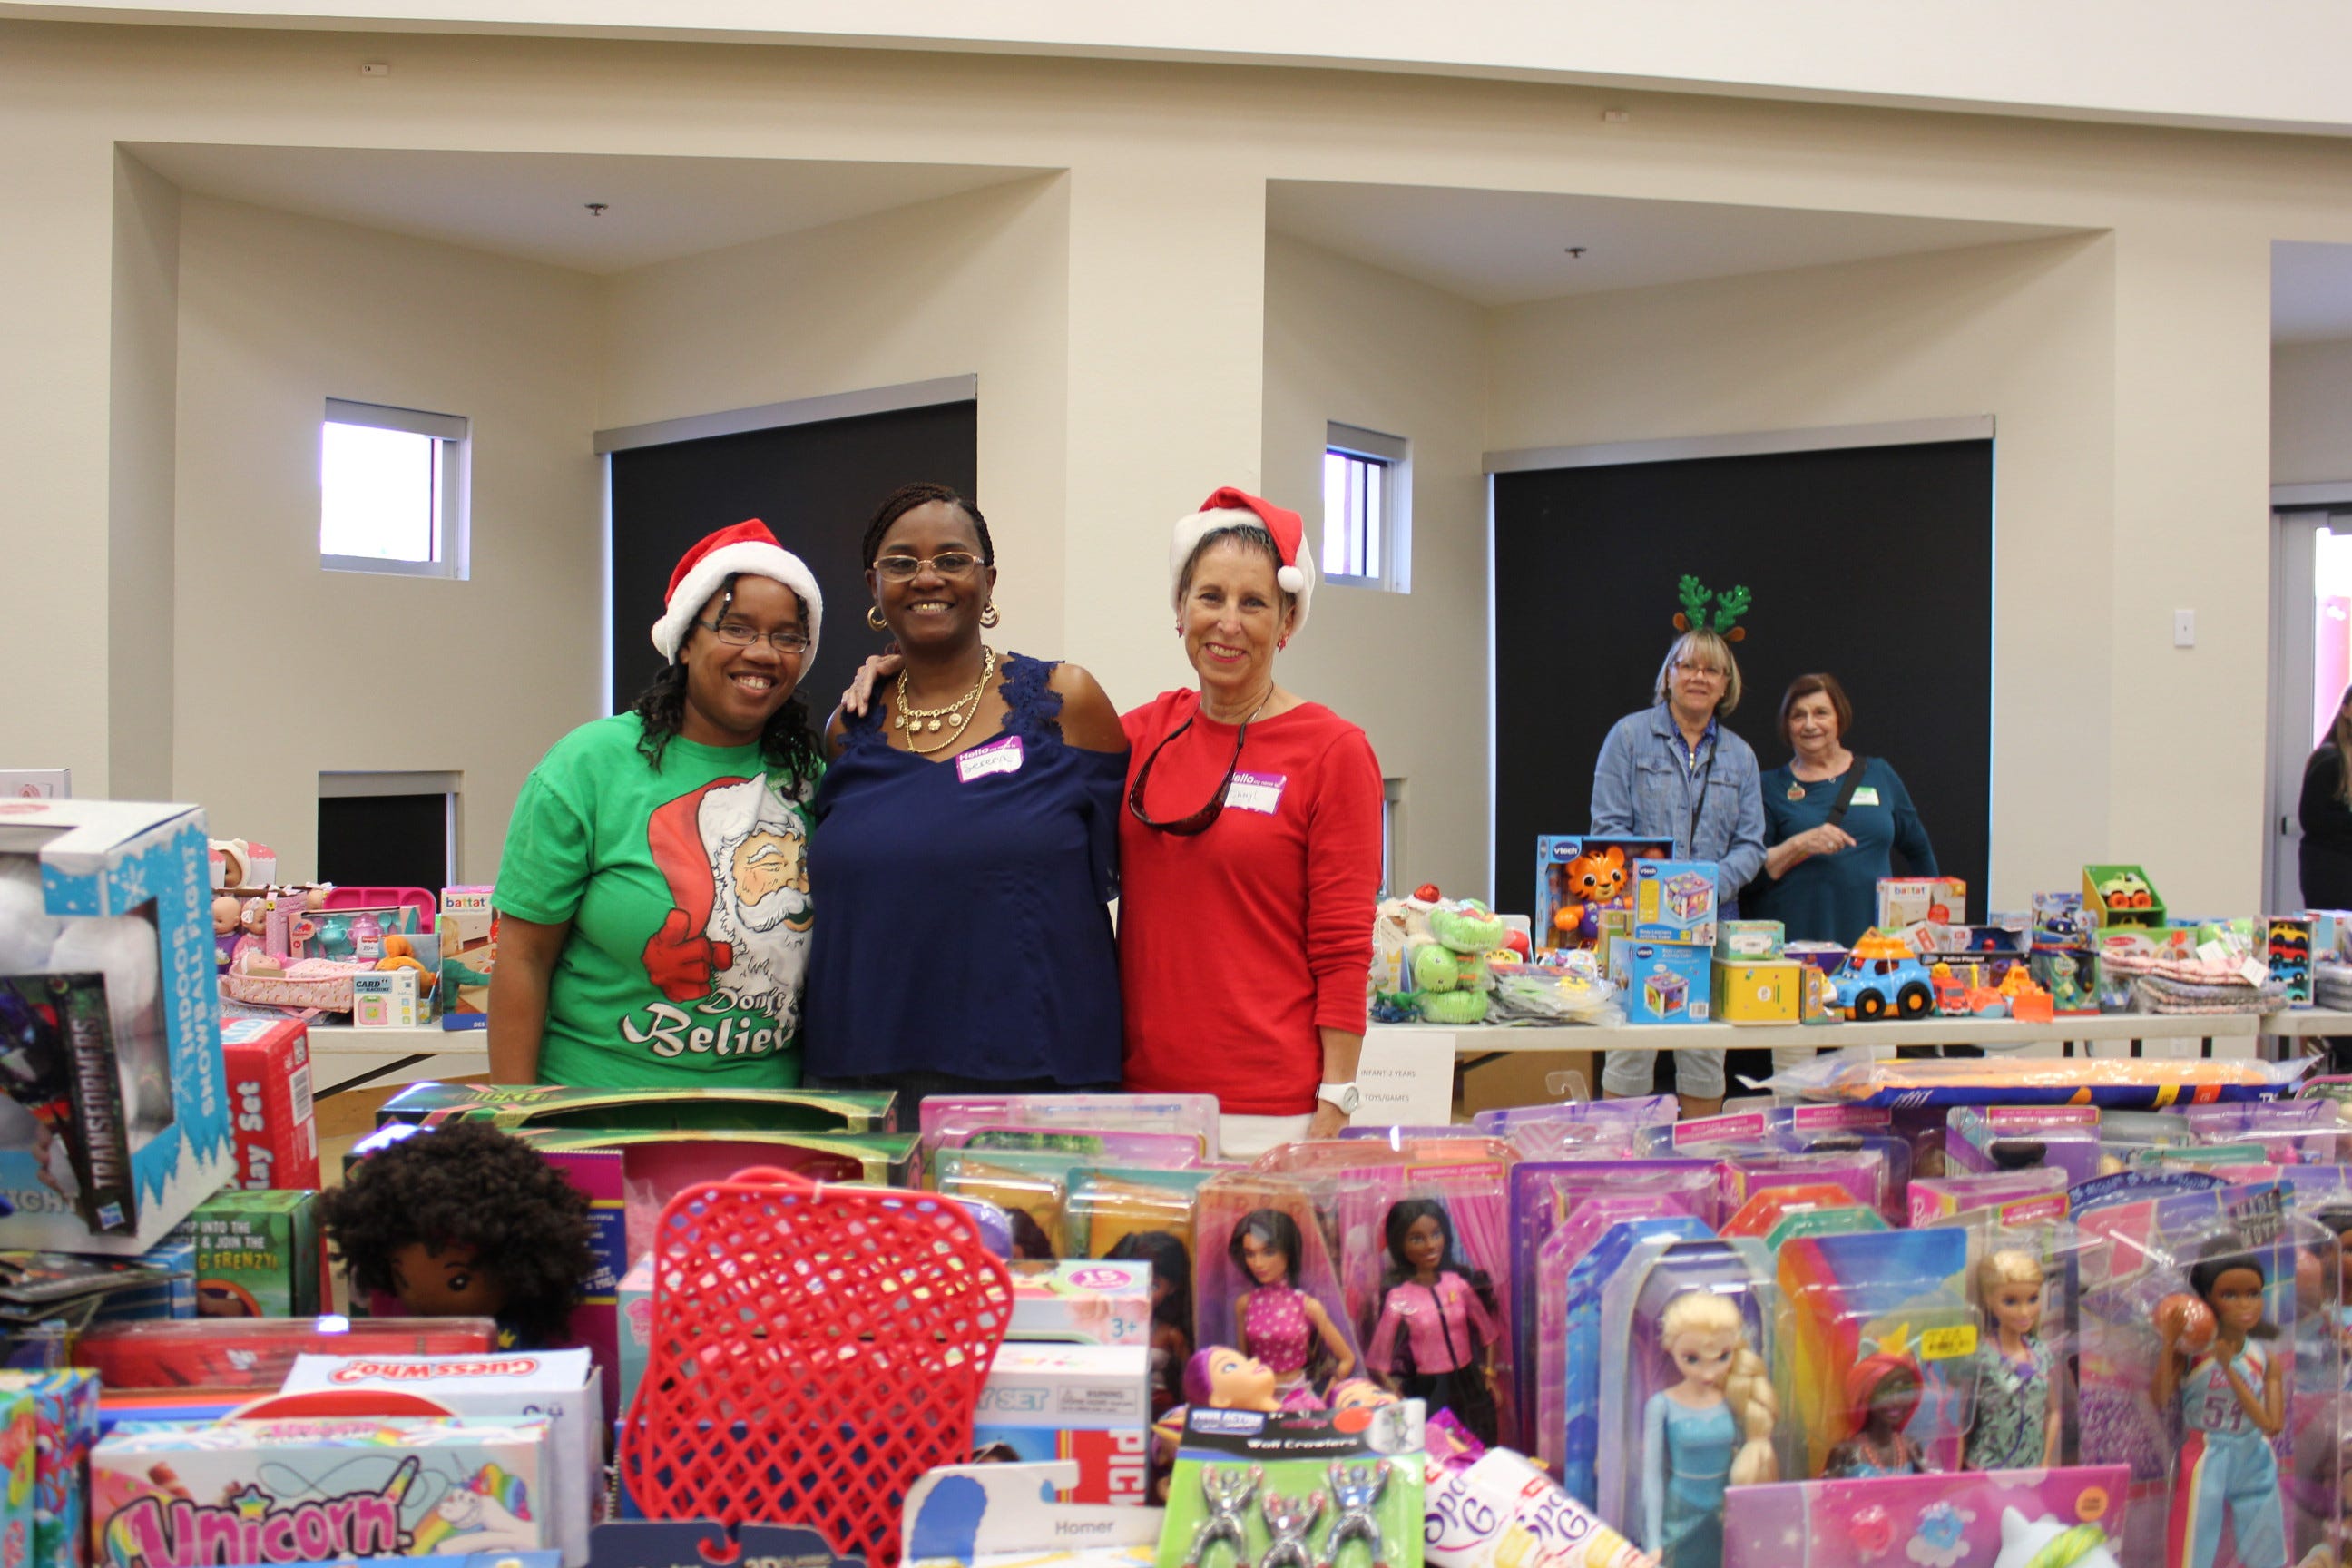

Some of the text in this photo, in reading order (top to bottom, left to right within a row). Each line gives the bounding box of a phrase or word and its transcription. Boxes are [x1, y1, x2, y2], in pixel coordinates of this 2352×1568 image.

[959, 747, 989, 760] Hello
[1232, 772, 1254, 783] ello
[1553, 847, 1577, 855] vtech
[1894, 885, 1926, 895] battat
[446, 896, 485, 907] battat
[181, 845, 216, 1118] SNOWBALL FIGHT
[172, 924, 195, 1059] INDOOR
[1394, 1069, 1416, 1078] YEARS
[72, 1019, 122, 1190] TRANSFORMERS
[1365, 1093, 1409, 1102] TOYS/GAMES
[237, 1081, 274, 1191] lay Set
[201, 1220, 228, 1234] INTO
[230, 1220, 250, 1234] THE
[214, 1235, 241, 1250] JOIN
[244, 1235, 266, 1250] THE
[213, 1251, 279, 1271] FRENZY!
[1112, 1318, 1137, 1338] 3+
[331, 1359, 535, 1383] Guess Who?
[998, 1387, 1050, 1412] SET
[1283, 1436, 1358, 1450] Crawlers
[122, 1485, 399, 1568] Unicorn
[1054, 1520, 1114, 1535] Homer
